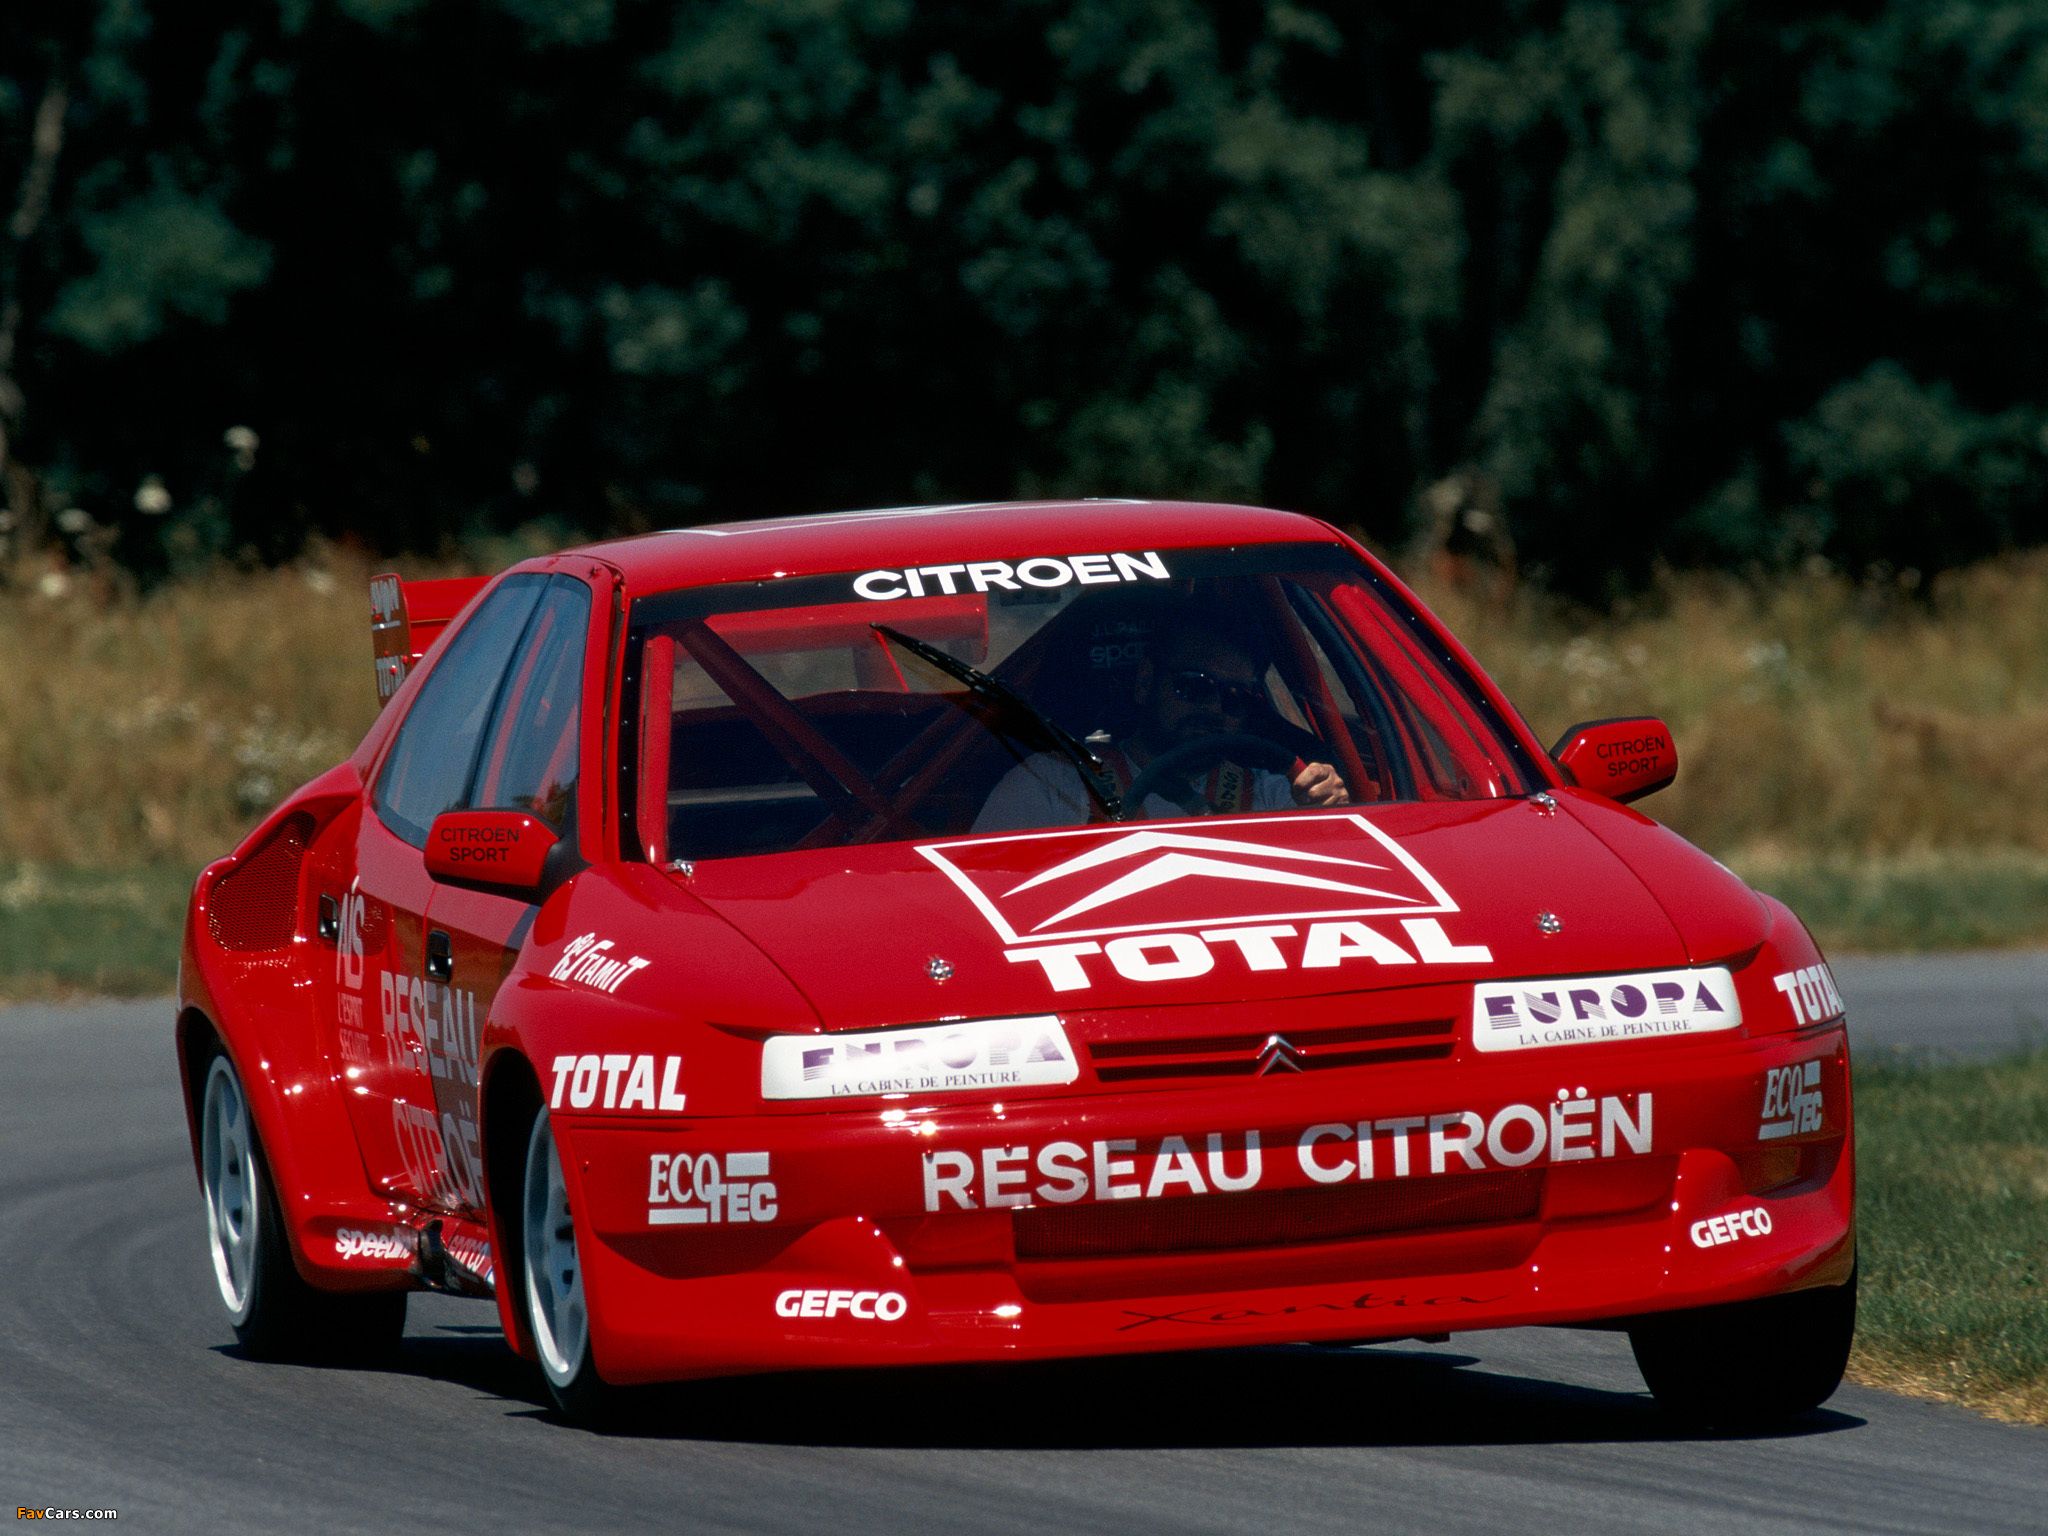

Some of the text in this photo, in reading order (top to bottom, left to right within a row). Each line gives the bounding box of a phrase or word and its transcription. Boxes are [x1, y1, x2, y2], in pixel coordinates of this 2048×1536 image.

[853, 552, 1170, 601] CITROEN
[1608, 755, 1658, 777] SPORT
[450, 847, 509, 861] SPORT
[1004, 917, 1493, 992] TOTAL
[1484, 979, 1724, 1031] EUROPA
[381, 970, 478, 1088] RESEAU
[1519, 1019, 1692, 1046] LA CABINE DE PEINTURE
[551, 1054, 686, 1111] TOTAL
[831, 1070, 1022, 1096] LA CABINE DE PEINTURE
[922, 1086, 1654, 1213] RESEAU CITROËN
[1690, 1207, 1773, 1249] GEFCO
[775, 1289, 907, 1322] GEFCO
